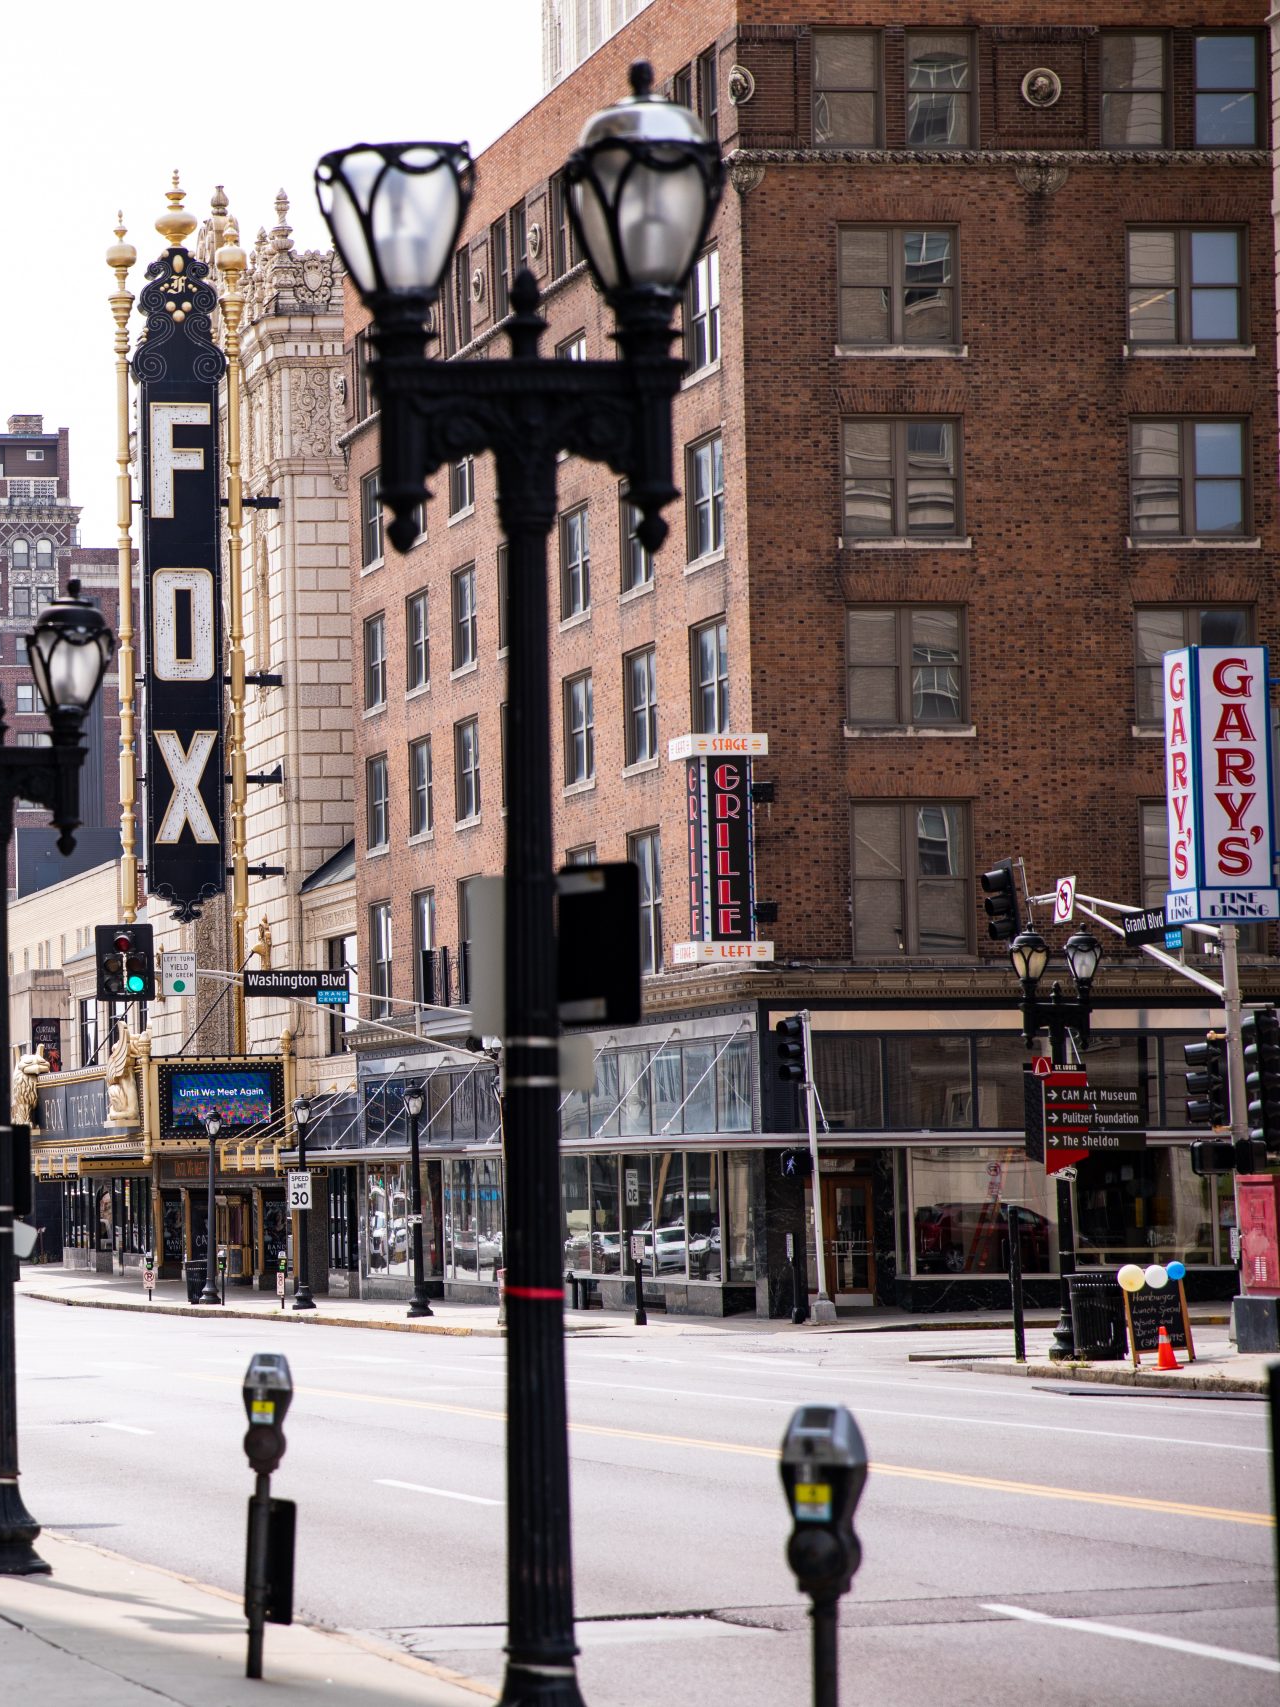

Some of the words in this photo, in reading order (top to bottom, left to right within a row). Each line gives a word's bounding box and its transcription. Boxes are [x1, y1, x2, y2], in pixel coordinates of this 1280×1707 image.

[150, 402, 219, 844] FOX
[712, 738, 748, 750] STAGE
[1169, 662, 1192, 880] GARY'S
[1212, 657, 1264, 876] GARY'S
[688, 767, 699, 935] GRILLE
[714, 763, 741, 934] GRILLE
[1174, 894, 1189, 907] FINE
[1221, 892, 1259, 903] FINE
[1171, 906, 1193, 920] DINING
[1210, 905, 1269, 916] DINING
[1125, 914, 1147, 932] Grand
[1147, 911, 1164, 929] Blvd
[721, 945, 752, 957] LEFT
[248, 974, 317, 990] Washington
[321, 974, 346, 986] Blvd
[36, 1042, 57, 1050] LUNGE
[179, 1088, 199, 1097] Until
[201, 1088, 215, 1096] We
[217, 1088, 238, 1096] Meet
[240, 1087, 264, 1097] Again
[1061, 1089, 1080, 1100] CAM
[1083, 1089, 1097, 1100] Art
[1100, 1090, 1137, 1101] Museum
[44, 1098, 64, 1131] FOX
[70, 1092, 110, 1128] THEAT
[1062, 1112, 1092, 1124] Pulitzer
[1095, 1112, 1139, 1124] Foundation
[1062, 1135, 1079, 1146] The
[1082, 1135, 1119, 1147] Sheldon
[291, 1192, 309, 1205] 30
[1132, 1291, 1176, 1304] Hamburger
[1132, 1305, 1157, 1315] Lunch
